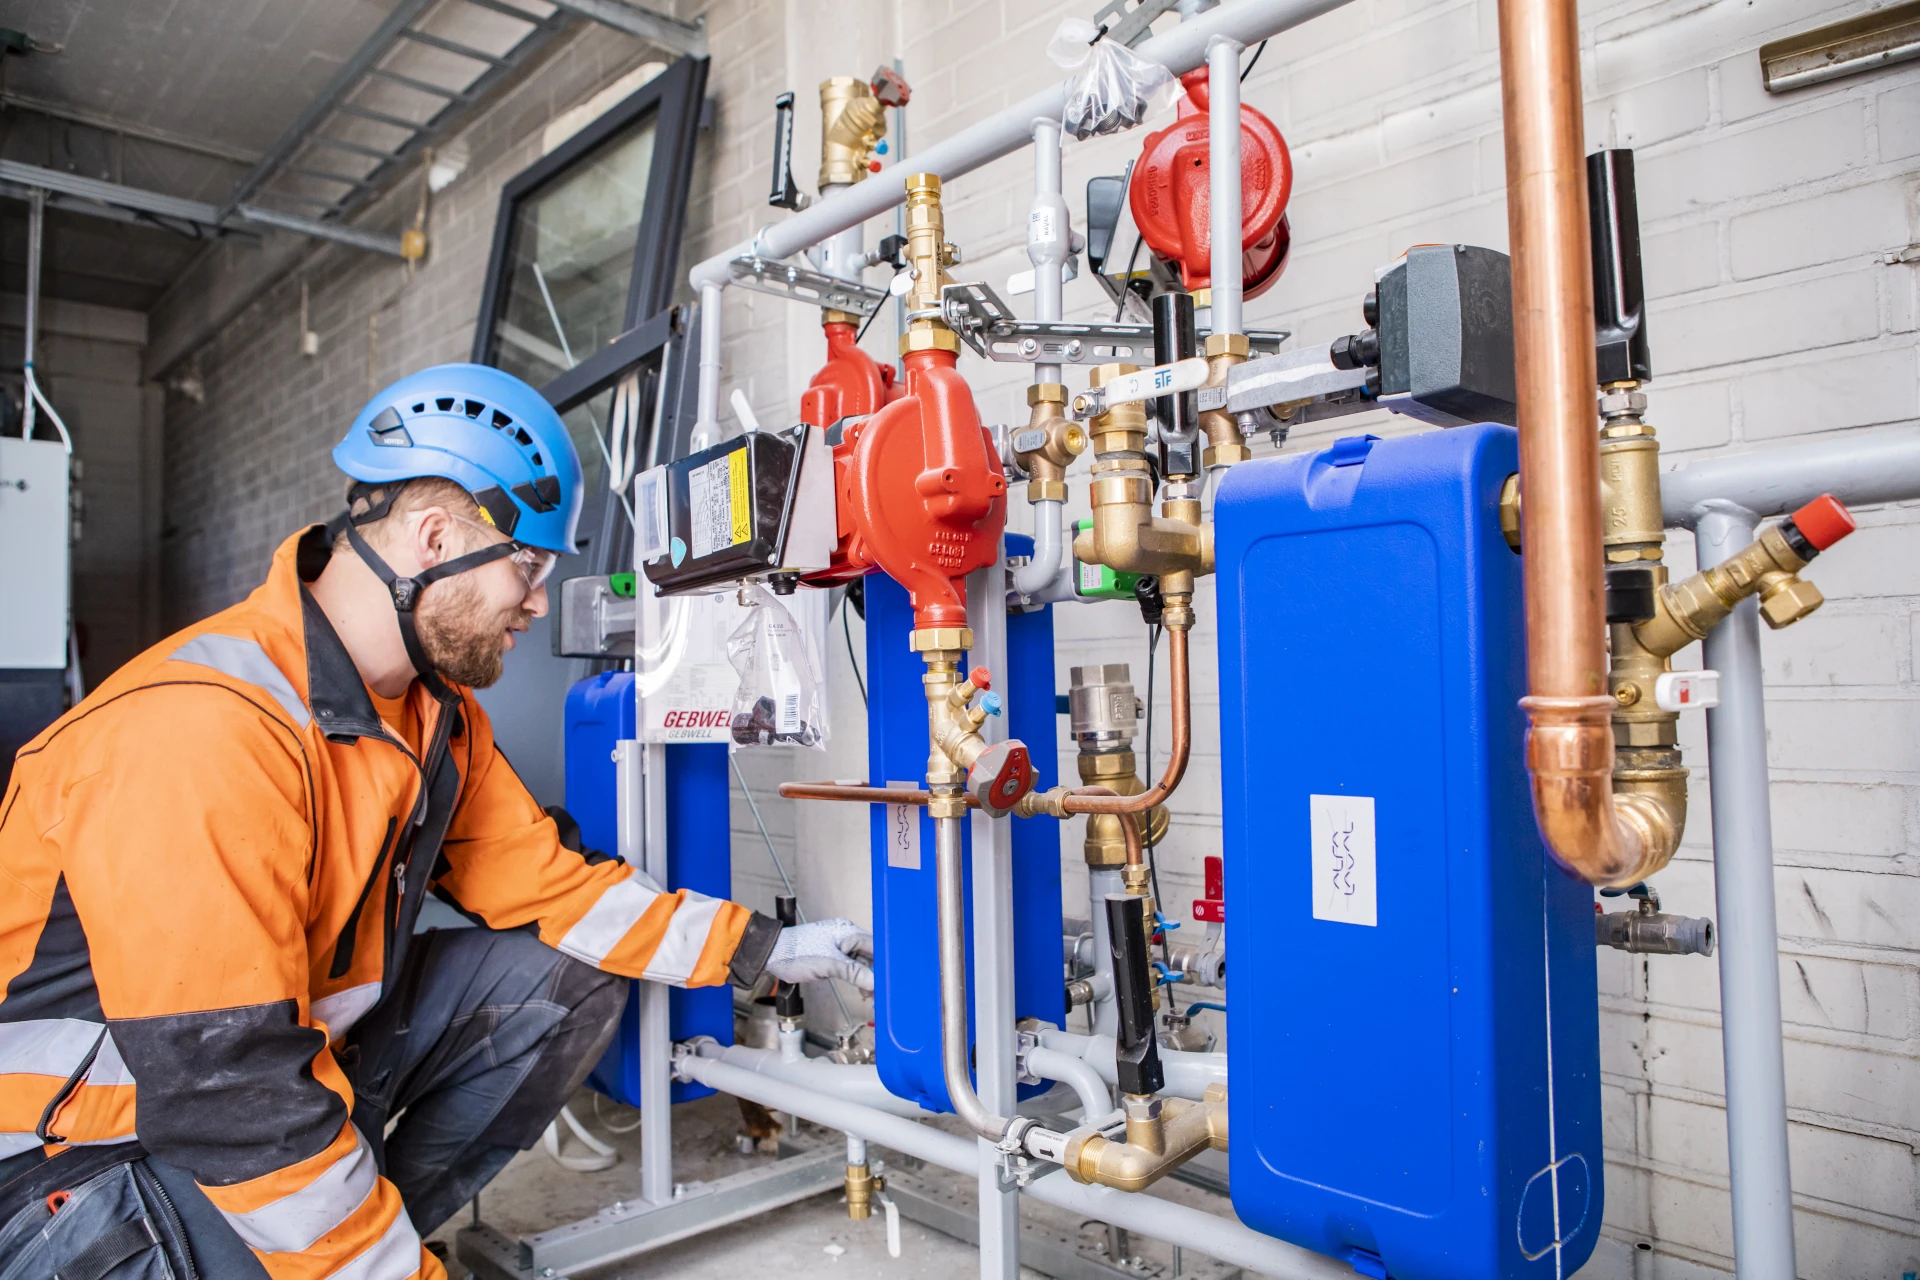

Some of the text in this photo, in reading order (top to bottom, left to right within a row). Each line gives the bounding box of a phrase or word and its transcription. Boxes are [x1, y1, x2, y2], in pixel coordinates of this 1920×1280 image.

[1154, 368, 1172, 389] STF
[1612, 507, 1627, 528] 25
[664, 711, 731, 728] GEBWEL
[668, 730, 712, 738] GEBWELL
